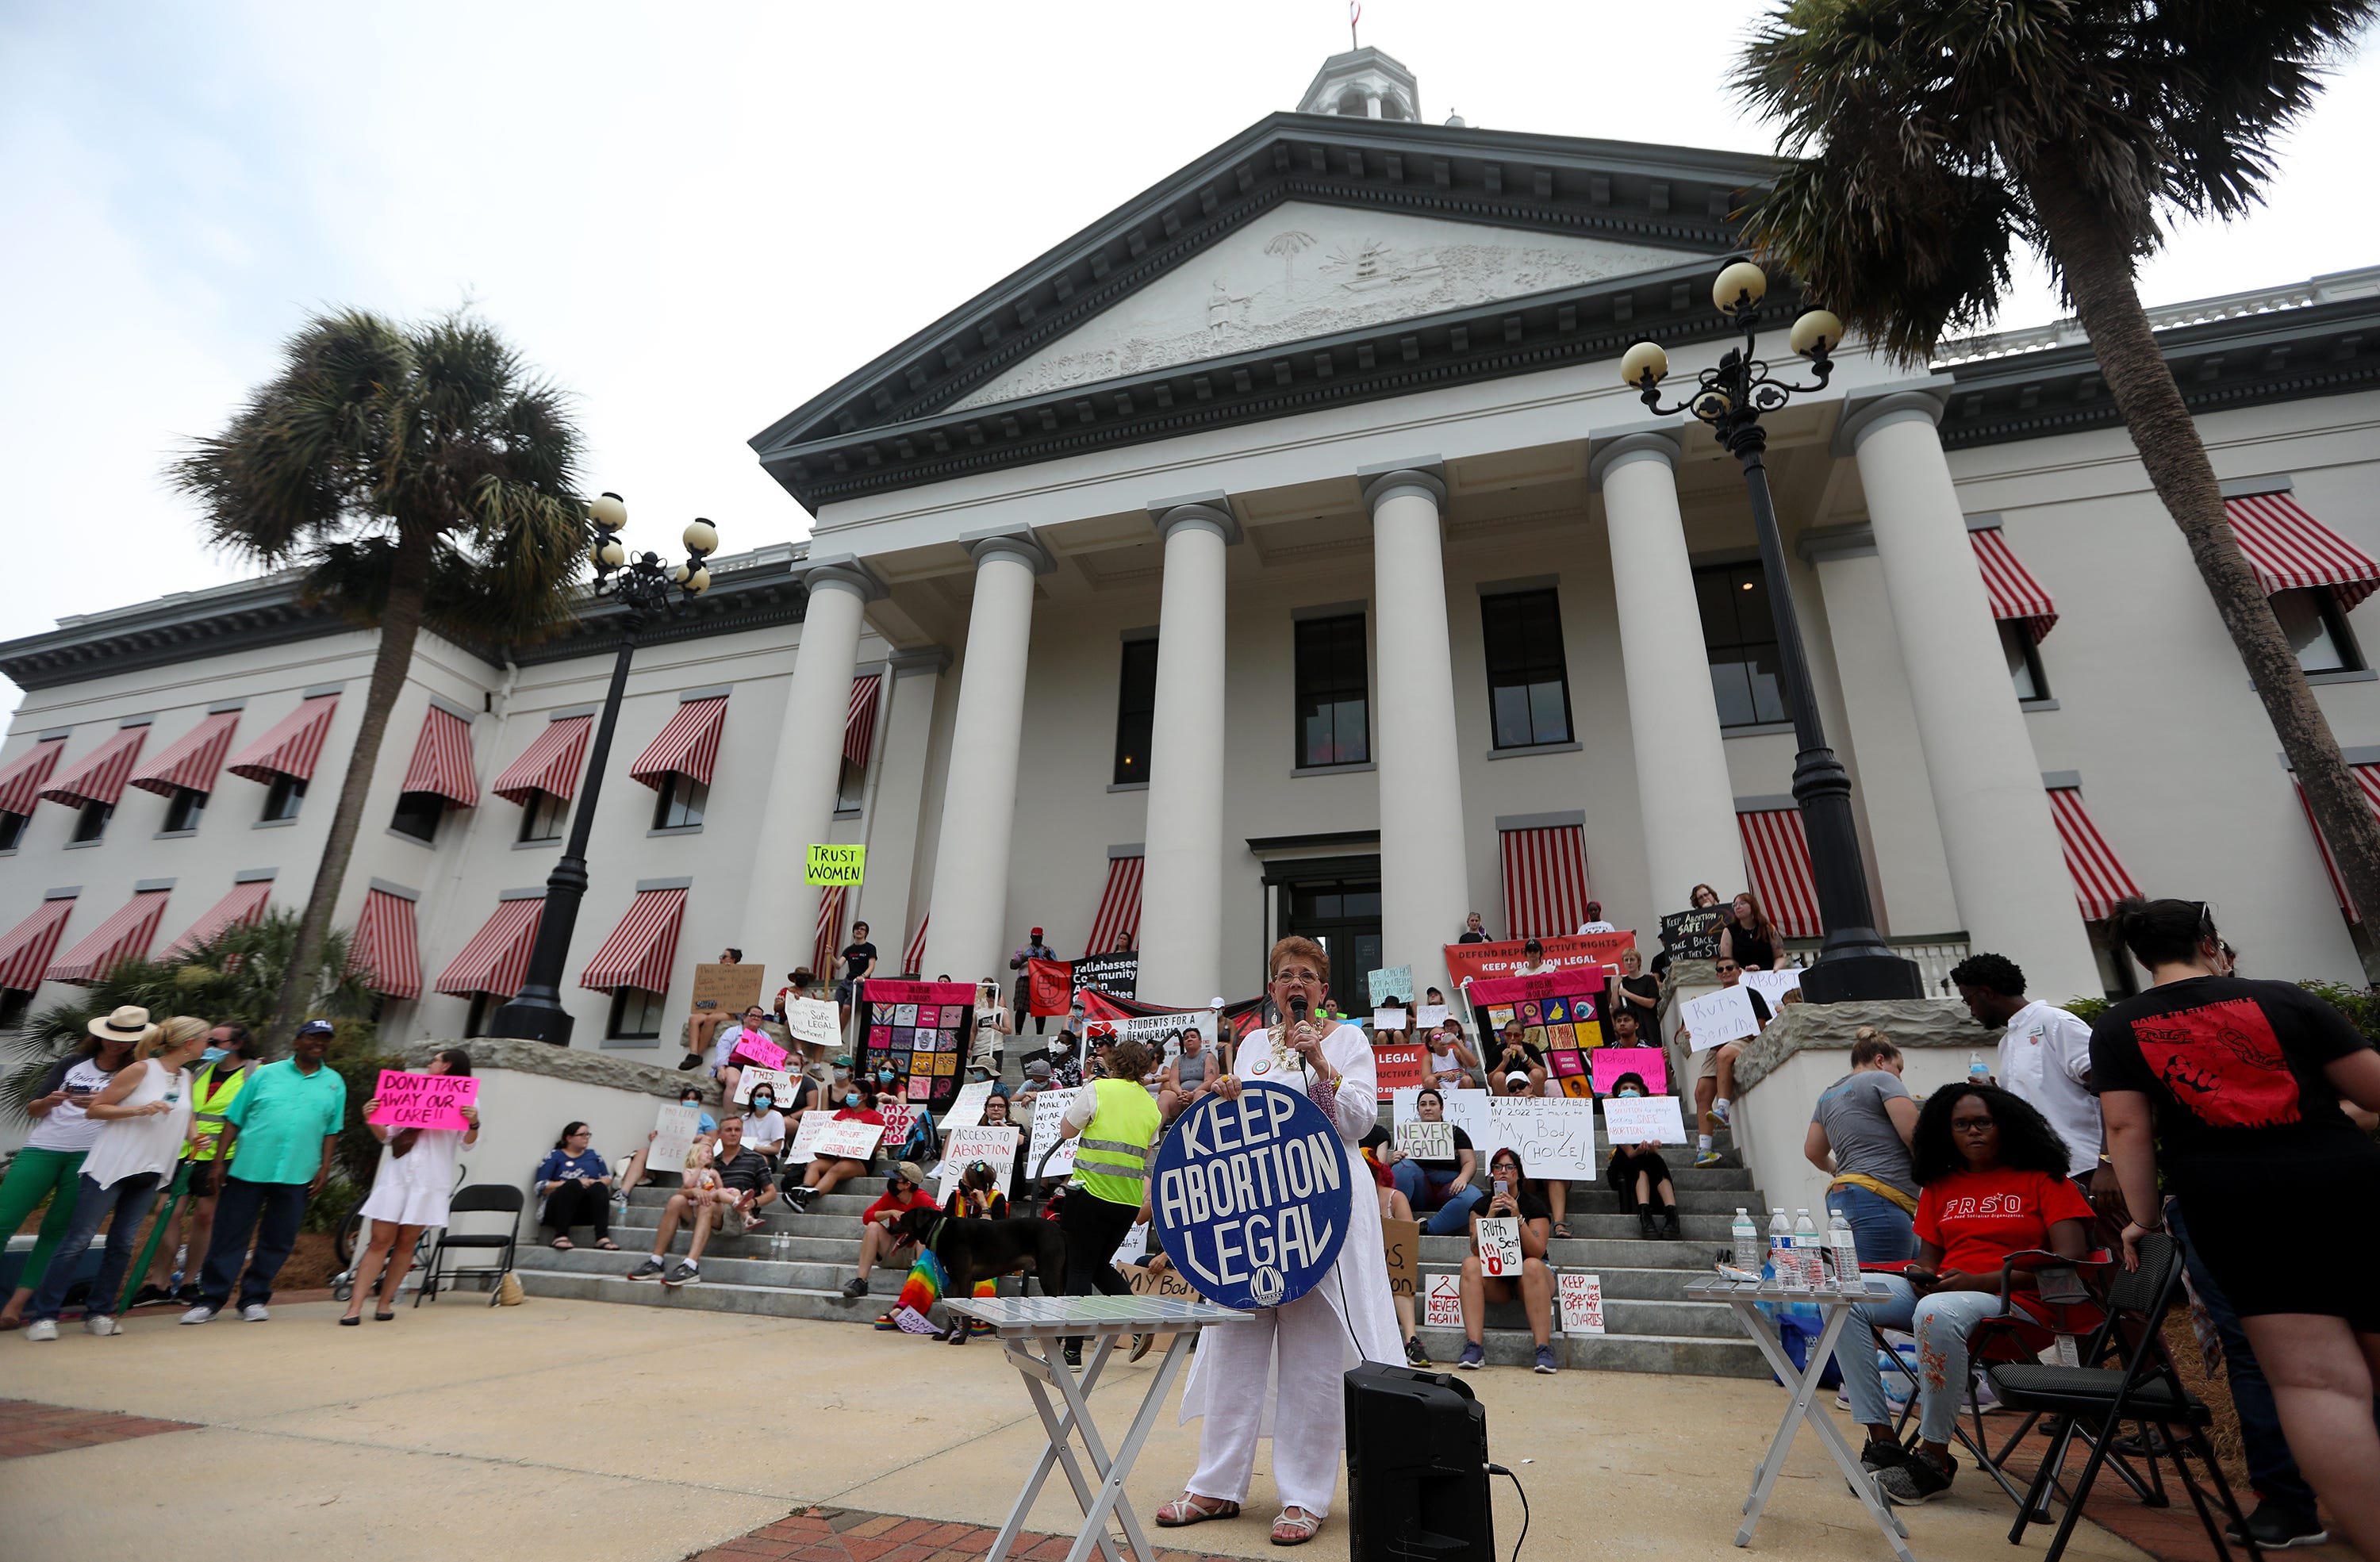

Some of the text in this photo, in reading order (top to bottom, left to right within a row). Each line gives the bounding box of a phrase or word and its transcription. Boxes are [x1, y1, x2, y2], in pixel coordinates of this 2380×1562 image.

[813, 846, 856, 862] TRUST
[807, 864, 860, 881] WOMEN
[1667, 912, 1717, 928] KEEP ABORTION
[1678, 921, 1704, 935] SAFE!
[1458, 950, 1498, 959] DEFEND
[1580, 938, 1618, 950] RIGHTS
[1671, 936, 1714, 951] TAKE BACK
[1481, 954, 1597, 972] KEEP ABOION LEGAL
[1669, 952, 1684, 961] WHAT
[1075, 960, 1138, 974] Tallahassee
[1073, 969, 1137, 984] Comunity
[810, 1009, 830, 1021] Safe
[808, 1019, 836, 1030] LEGAL
[1127, 1015, 1196, 1030] STUDENTS FOR A
[792, 1024, 826, 1039] Abortions!
[1378, 1053, 1417, 1063] LEGAL
[752, 1069, 774, 1080] THIS
[436, 1077, 471, 1093] TAKE
[378, 1092, 455, 1108] AWAY OUR
[1039, 1092, 1054, 1102] YOU
[1500, 1098, 1590, 1107] UNBELIEVABLE
[1038, 1102, 1061, 1111] MAKE
[1450, 1103, 1465, 1113] TO
[394, 1108, 443, 1123] CARE!!
[1035, 1111, 1060, 1121] WEAR
[1181, 1088, 1296, 1160] KEEP
[954, 1129, 1010, 1142] ACCESS TO
[1396, 1123, 1453, 1140] NEVER
[1499, 1119, 1575, 1148] My Body
[951, 1143, 1011, 1158] ABORTION
[1064, 1139, 1077, 1149] HER
[1161, 1130, 1341, 1229] ABORTION
[1944, 1195, 2021, 1218] FRSO
[1184, 1203, 1333, 1286] LEGAL
[1498, 1237, 1519, 1249] Sent
[1121, 1268, 1194, 1295] MY Bod
[1250, 1266, 1284, 1298] NOW
[1562, 1275, 1584, 1288] KEEP
[1560, 1289, 1599, 1301] Rosaries
[1429, 1300, 1460, 1313] NEVER
[1564, 1300, 1598, 1312] OFF MY
[1428, 1313, 1460, 1324] AGAIN
[1571, 1312, 1604, 1326] OVARIES
